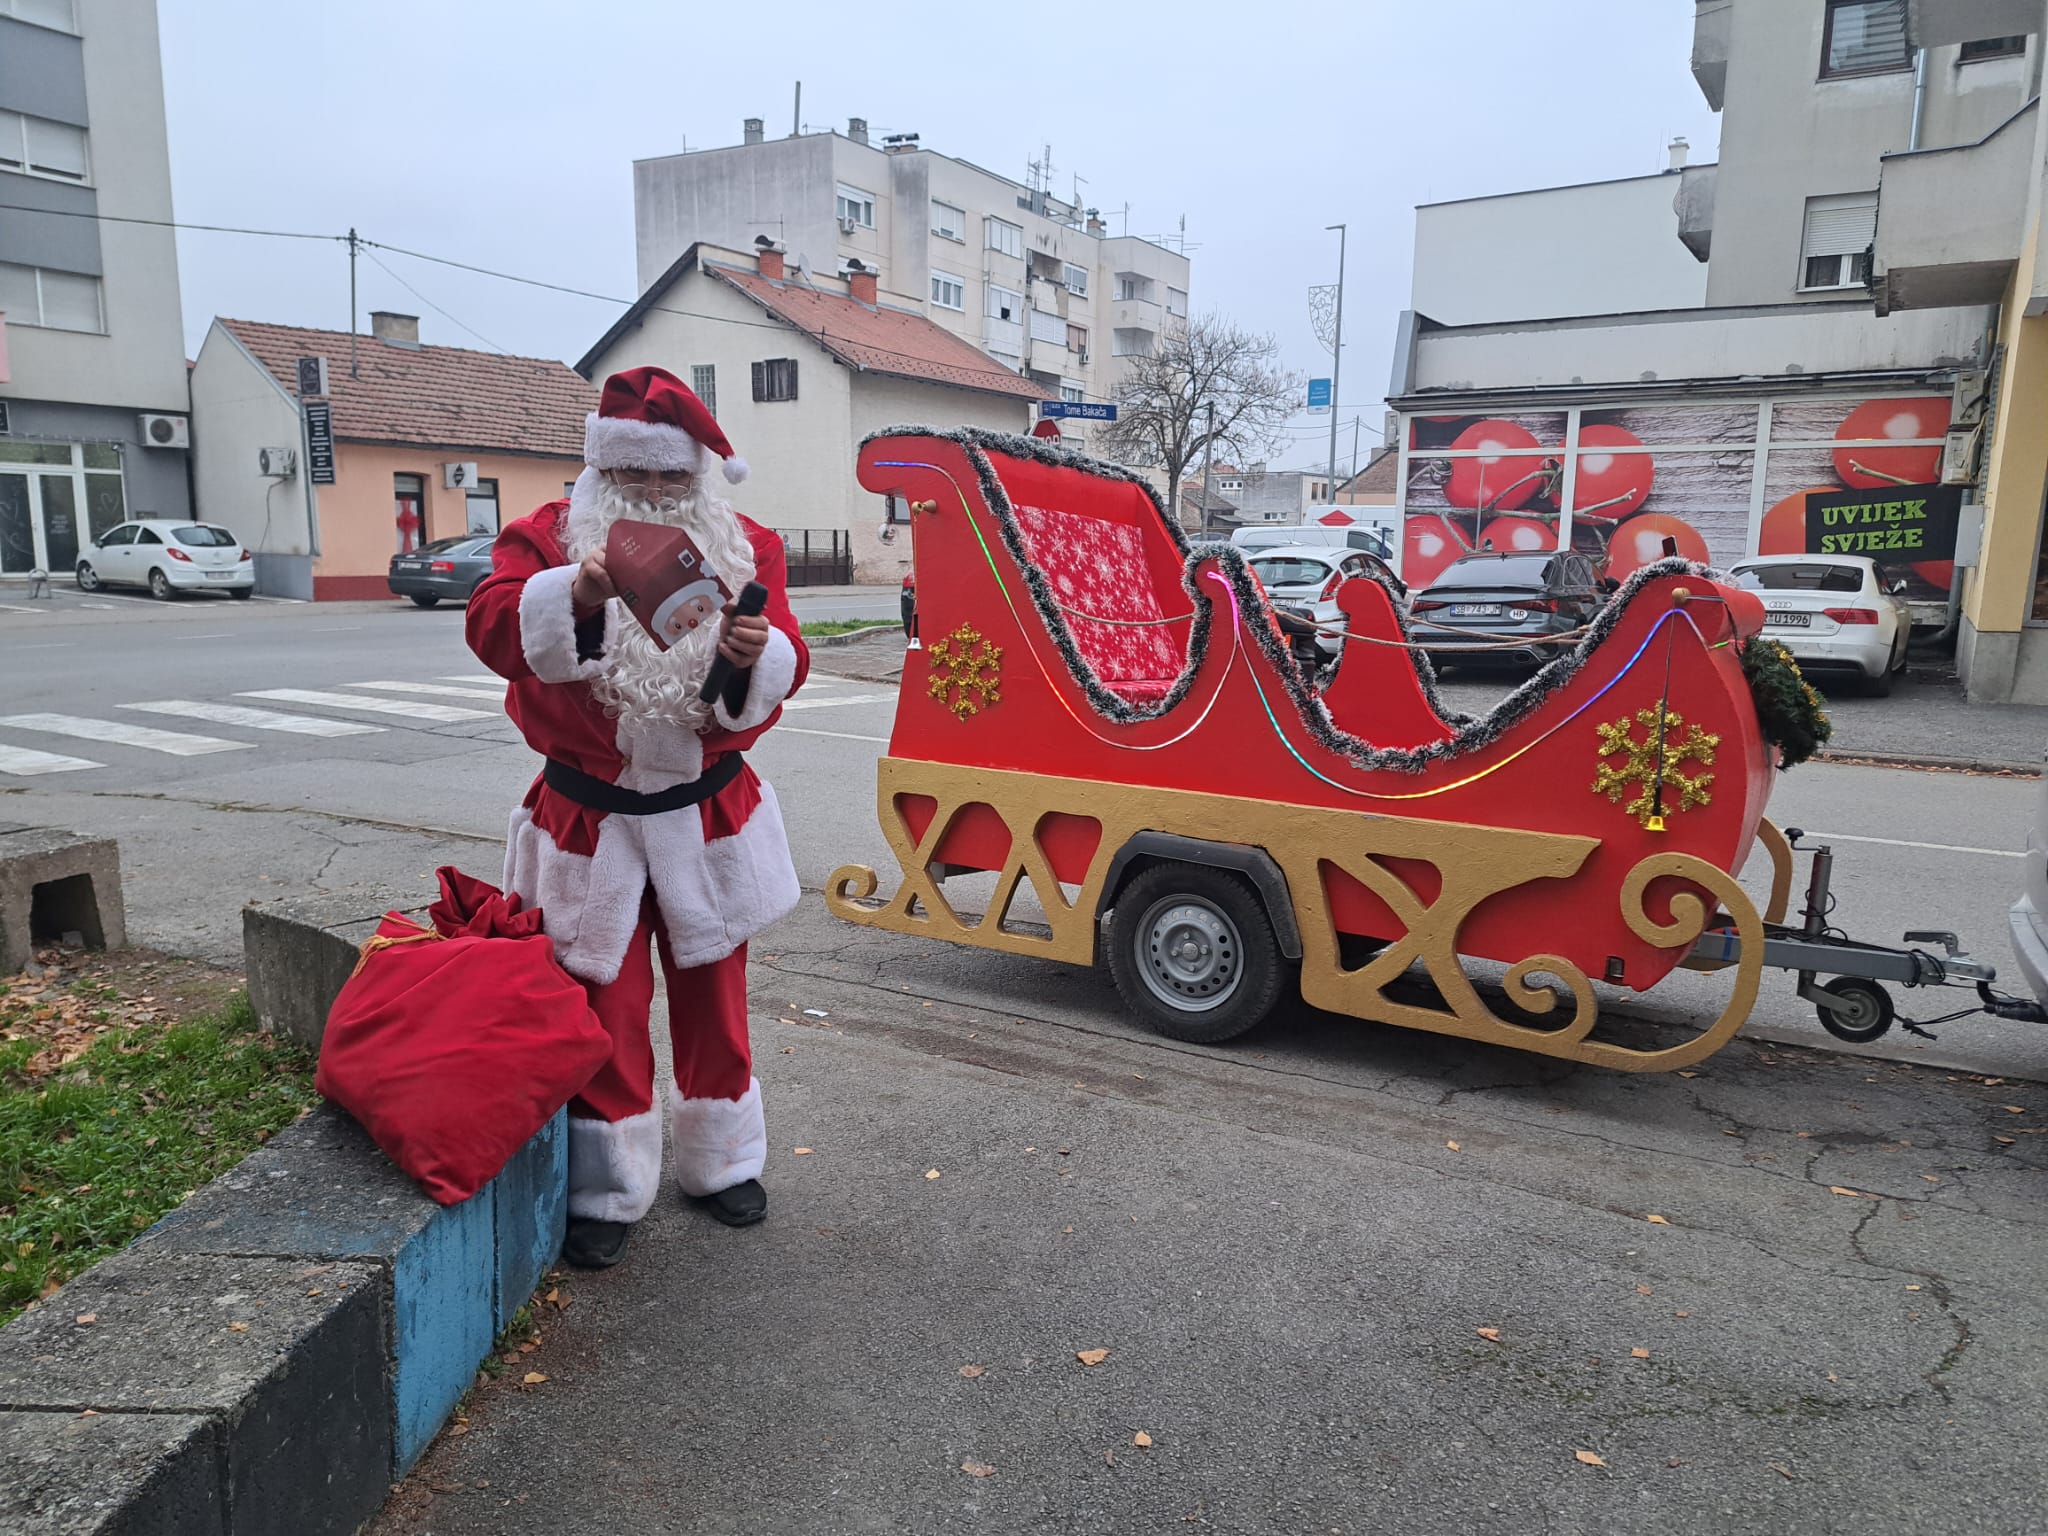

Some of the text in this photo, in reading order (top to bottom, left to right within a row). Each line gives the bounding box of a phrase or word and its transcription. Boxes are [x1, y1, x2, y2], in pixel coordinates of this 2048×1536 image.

[1063, 404, 1081, 415] Tome
[1821, 499, 1927, 526] UVIJEK
[1821, 523, 1923, 553] SVJEŽE
[1512, 610, 1525, 618] HR
